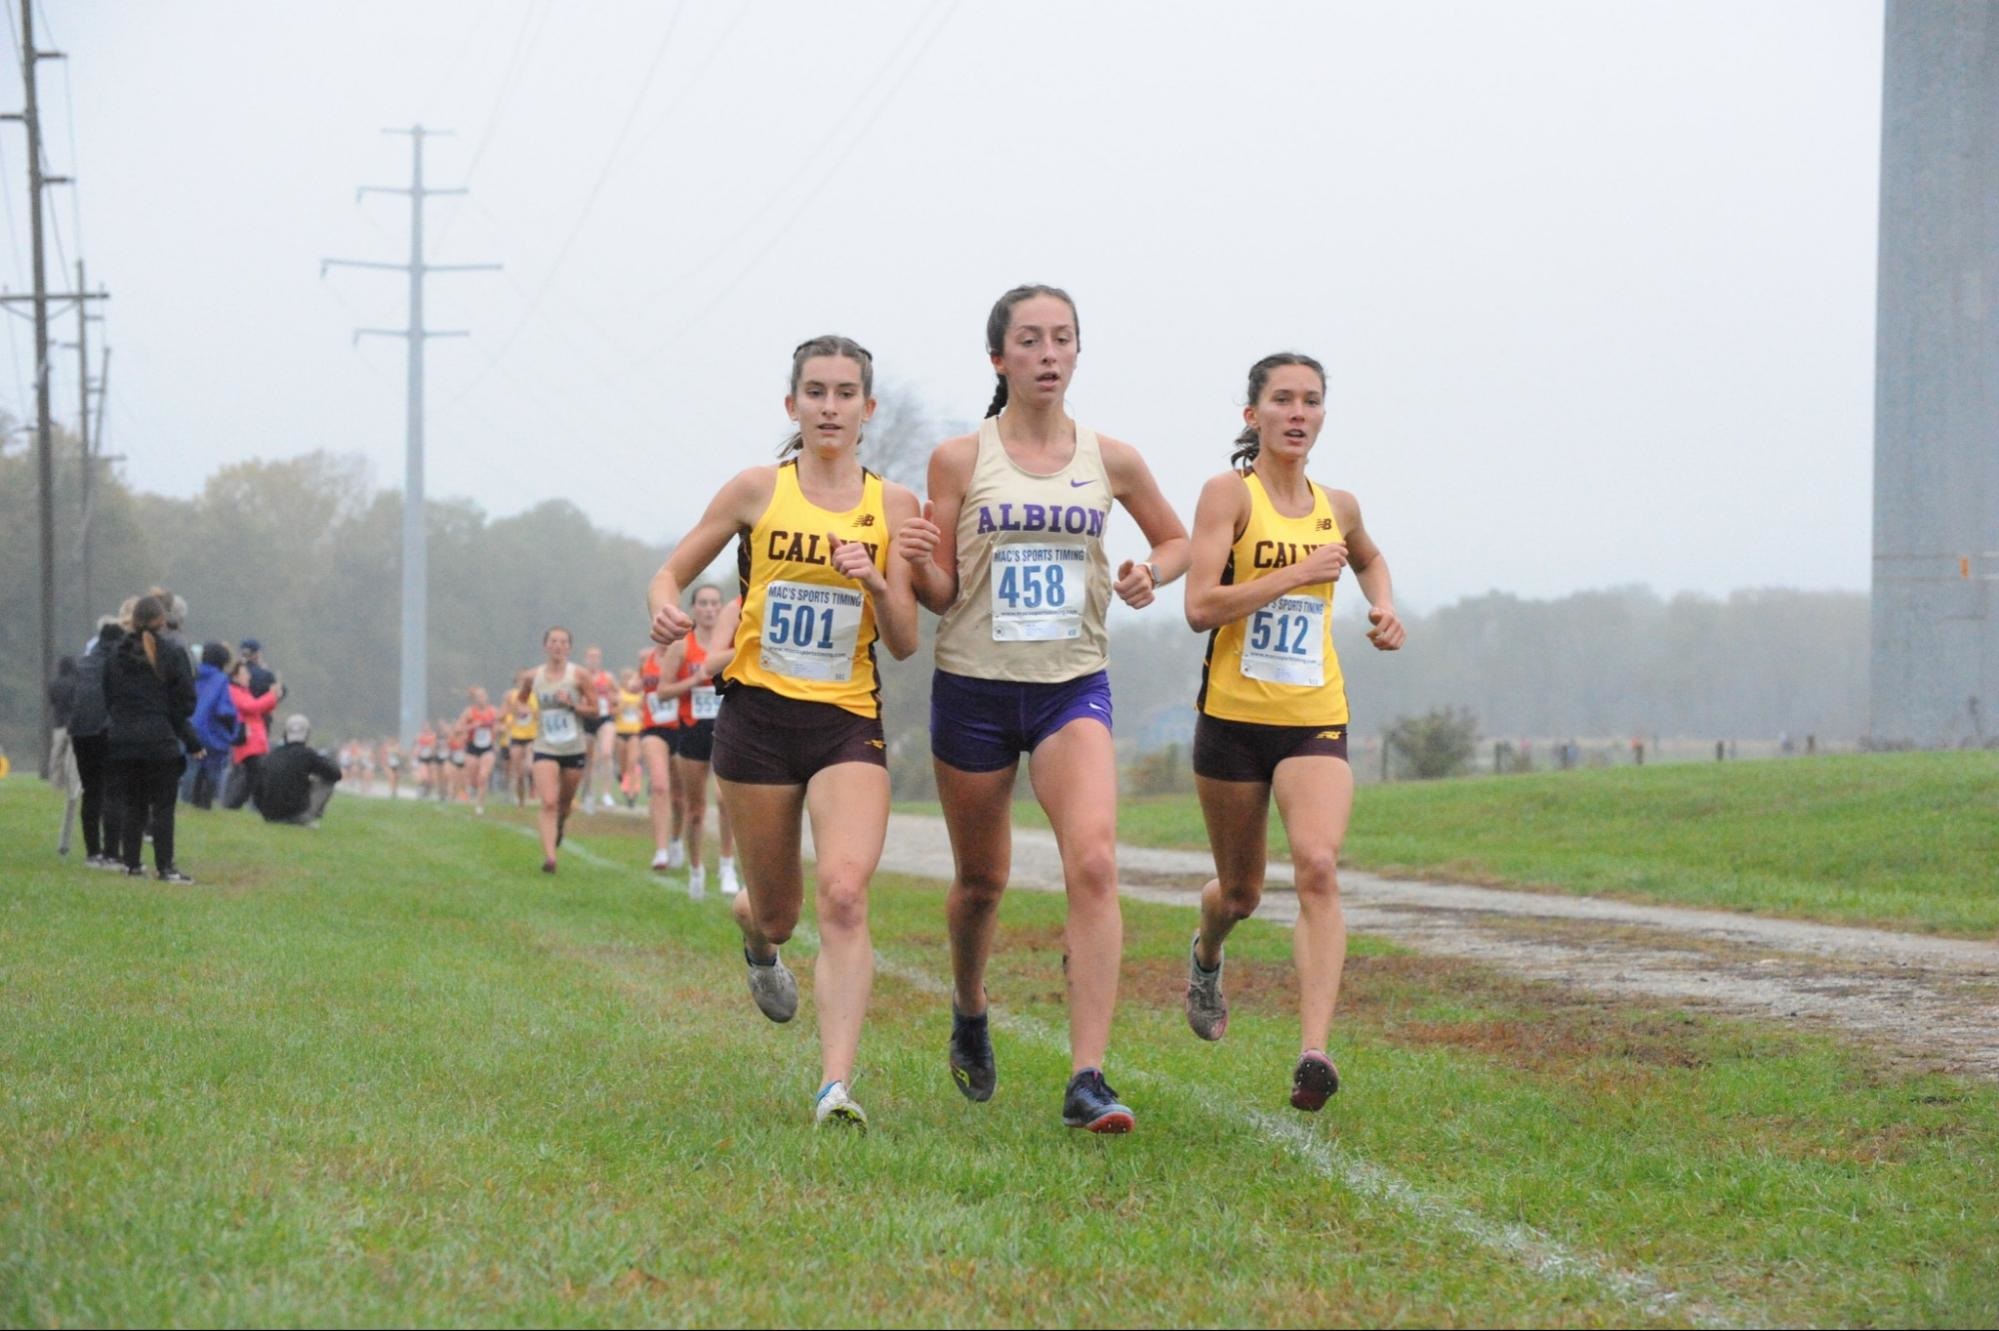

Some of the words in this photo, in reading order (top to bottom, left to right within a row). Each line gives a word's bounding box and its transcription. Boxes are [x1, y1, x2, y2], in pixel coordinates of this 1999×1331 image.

[977, 504, 1105, 538] ALBION
[1022, 549, 1053, 562] SPORTS
[1055, 549, 1084, 561] TIMING
[769, 586, 796, 601] MAC'S
[797, 588, 830, 604] SPORTS
[832, 592, 861, 607] TIMING
[998, 564, 1065, 608] 458
[769, 602, 834, 649] 501
[1252, 611, 1308, 655] 512
